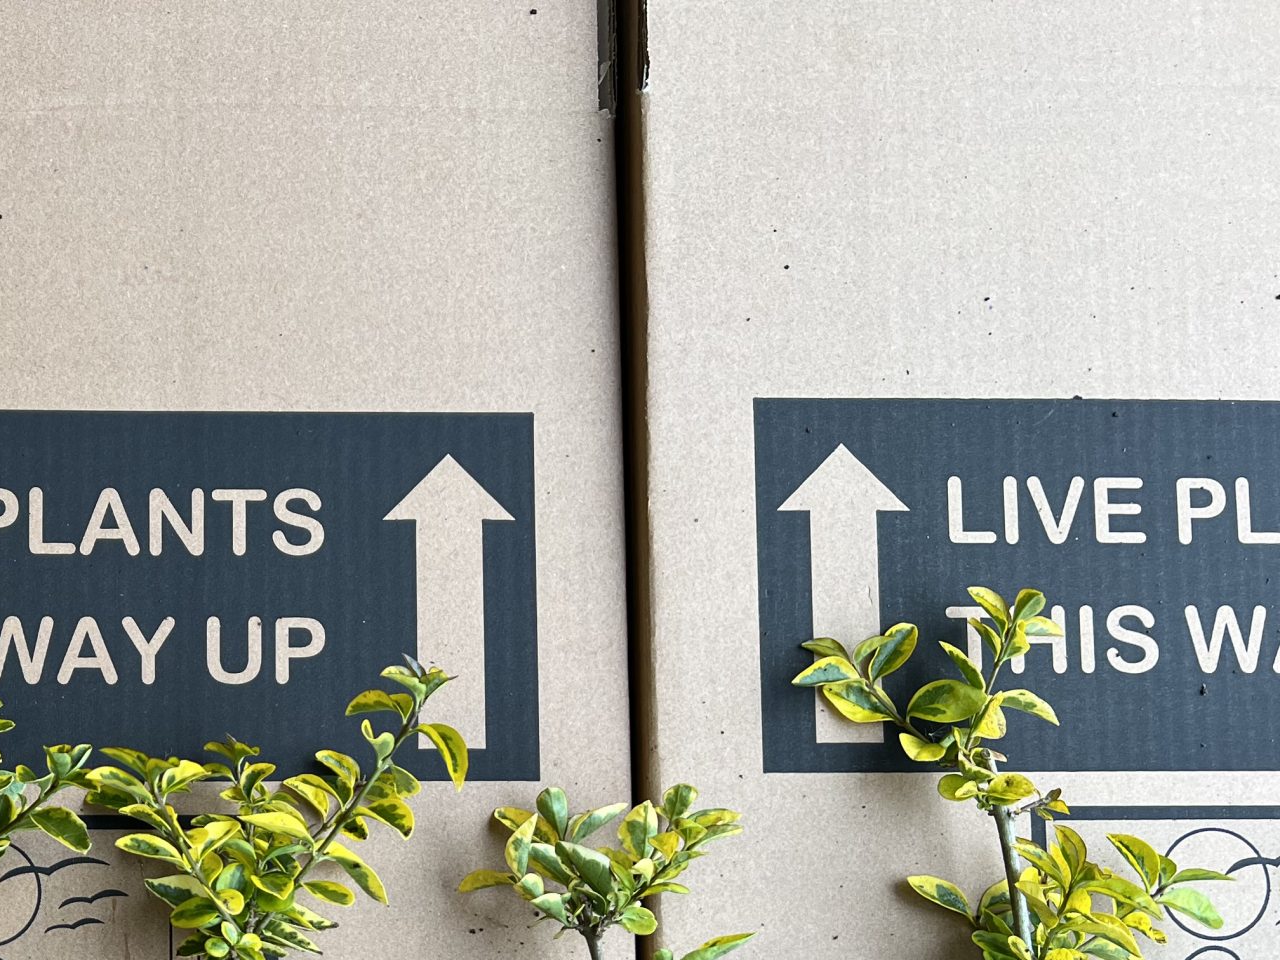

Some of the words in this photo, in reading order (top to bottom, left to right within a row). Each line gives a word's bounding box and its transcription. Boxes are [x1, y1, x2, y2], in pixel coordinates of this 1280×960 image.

[946, 475, 1148, 545] LIVE
[1175, 476, 1280, 545] PL
[206, 615, 326, 686] UP
[1184, 604, 1280, 675] W
